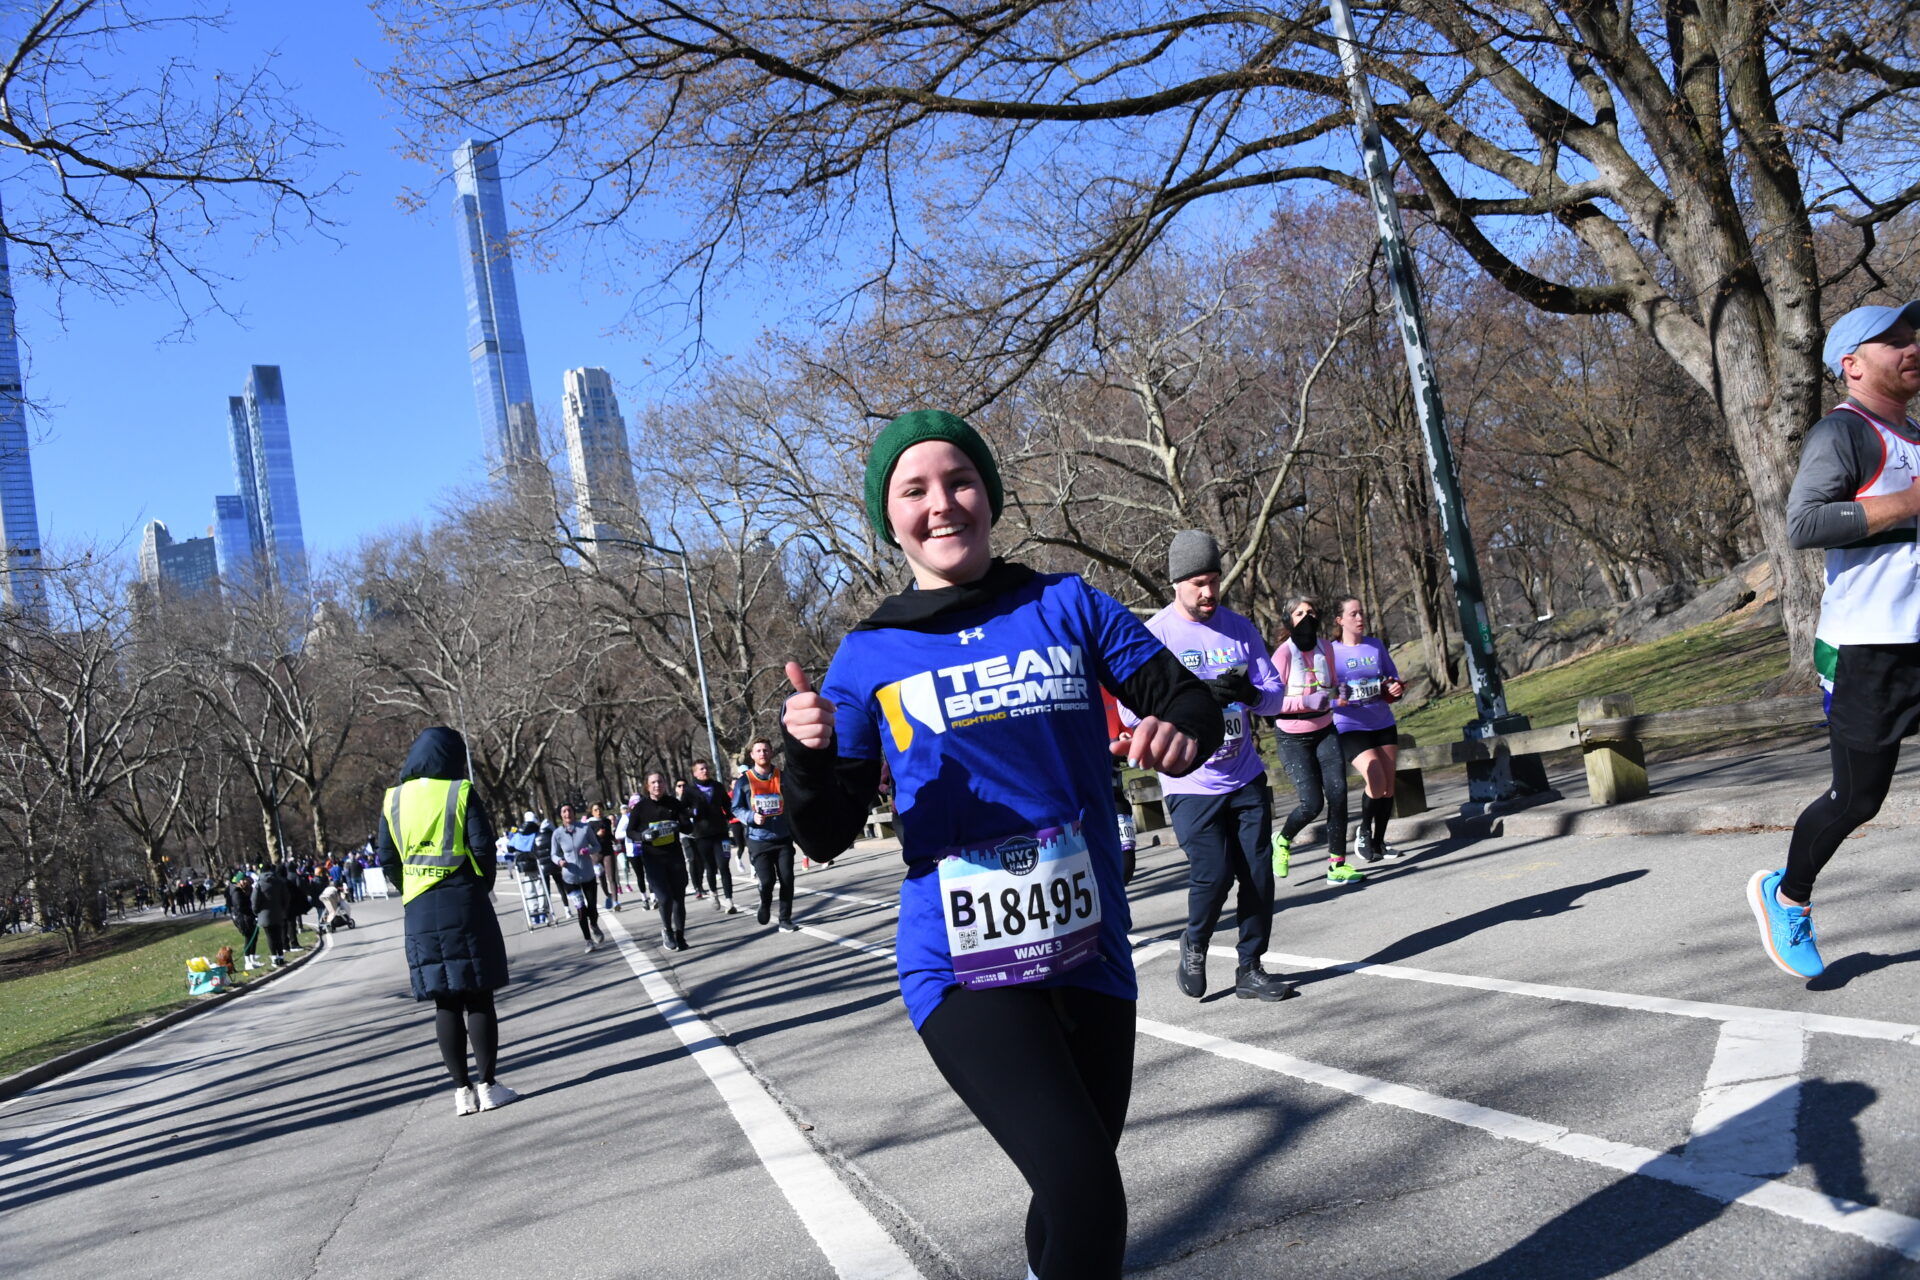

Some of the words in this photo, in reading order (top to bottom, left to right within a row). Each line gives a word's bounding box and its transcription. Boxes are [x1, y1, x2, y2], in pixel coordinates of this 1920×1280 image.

[1184, 655, 1199, 663] NYC
[937, 645, 1085, 692] TEAM
[944, 678, 1089, 719] BOOMER
[951, 711, 1008, 729] FIGHTING
[1010, 703, 1052, 718] CYSTIC
[1225, 718, 1241, 735] 80
[1005, 847, 1034, 863] NYC
[1009, 859, 1033, 870] HALF
[1014, 942, 1054, 960] WAVE
[1055, 940, 1063, 951] 3
[971, 976, 998, 985] AIRLINES
